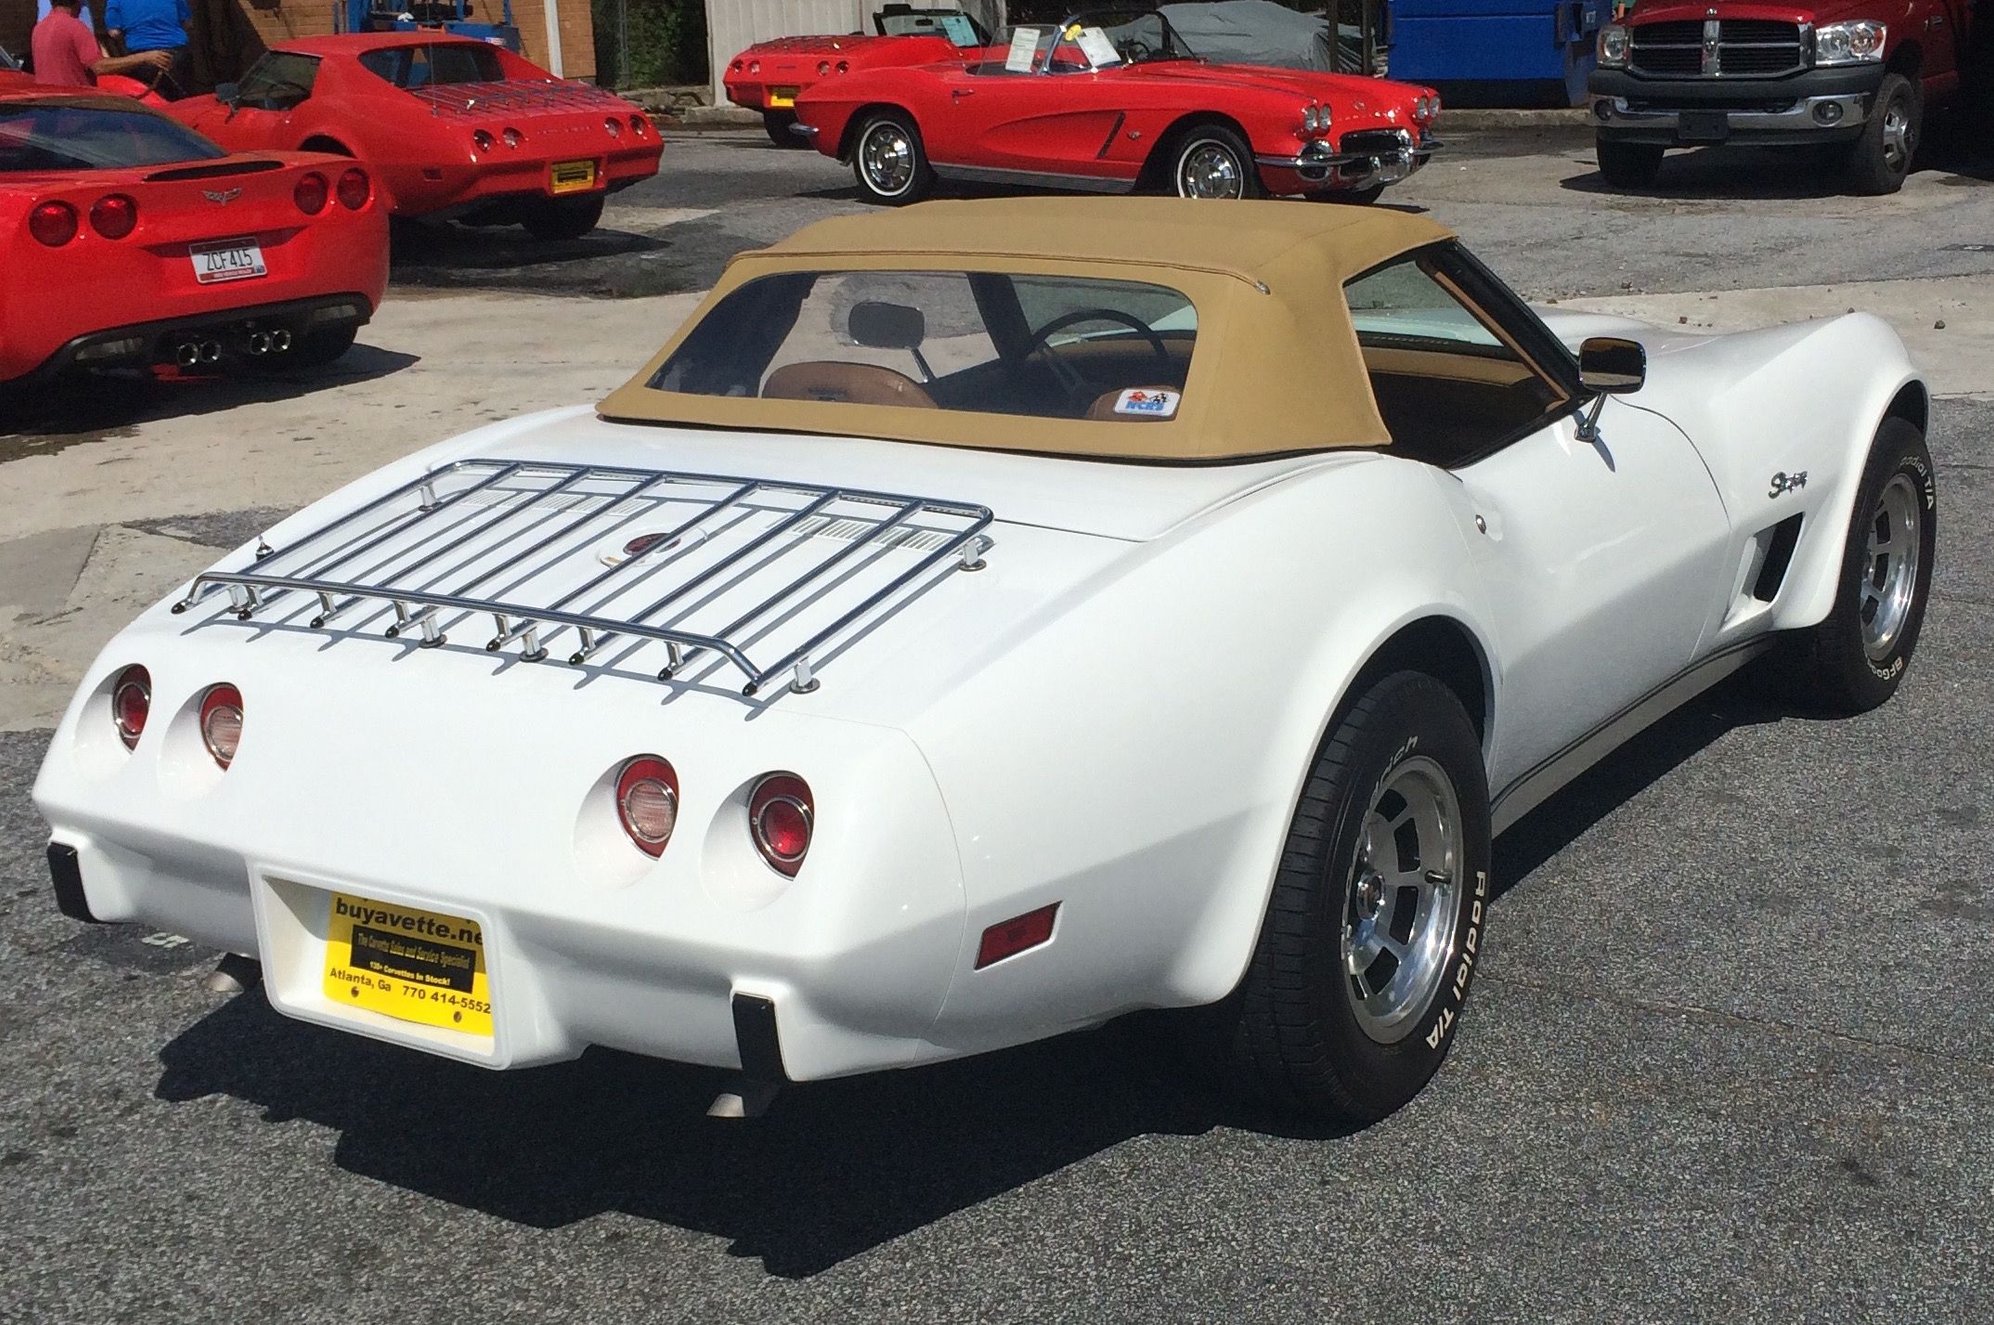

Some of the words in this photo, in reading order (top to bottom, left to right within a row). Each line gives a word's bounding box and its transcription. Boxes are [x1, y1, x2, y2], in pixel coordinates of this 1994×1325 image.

[202, 249, 253, 271] ZCF415
[336, 897, 483, 945] buyavette.ne
[329, 968, 375, 989] Atlanta,
[378, 979, 391, 992] Ga
[402, 985, 426, 1000] 770
[431, 991, 491, 1014] 414-5552
[425, 974, 451, 986] Stock!
[1426, 1007, 1455, 1049] T/A
